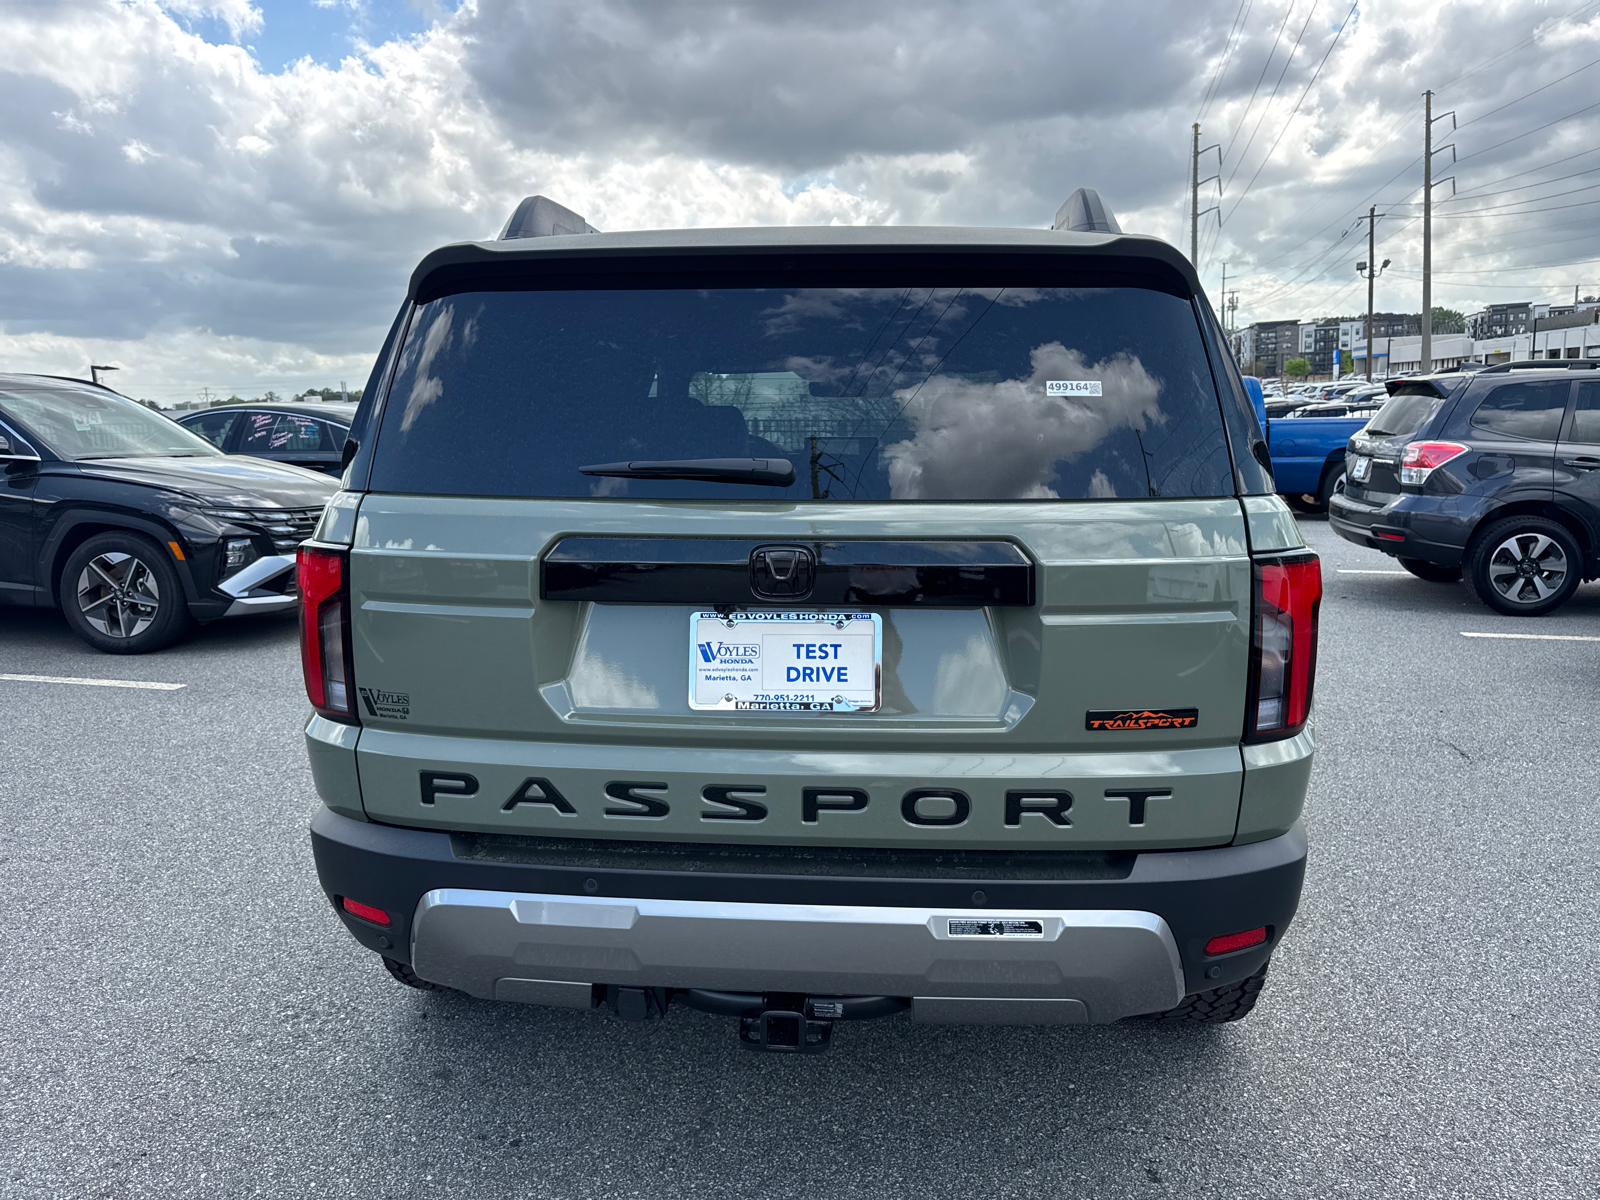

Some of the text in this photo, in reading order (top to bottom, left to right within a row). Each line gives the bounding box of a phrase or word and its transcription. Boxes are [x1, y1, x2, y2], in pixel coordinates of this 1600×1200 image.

[1048, 383, 1089, 391] 499164
[792, 643, 842, 660] TEST
[704, 674, 738, 682] Marietta,
[786, 666, 848, 682] DRIVE
[737, 701, 832, 710] Marietta, GA
[1090, 717, 1195, 730] TRAILSPORT
[419, 769, 1174, 829] PASSPORT
